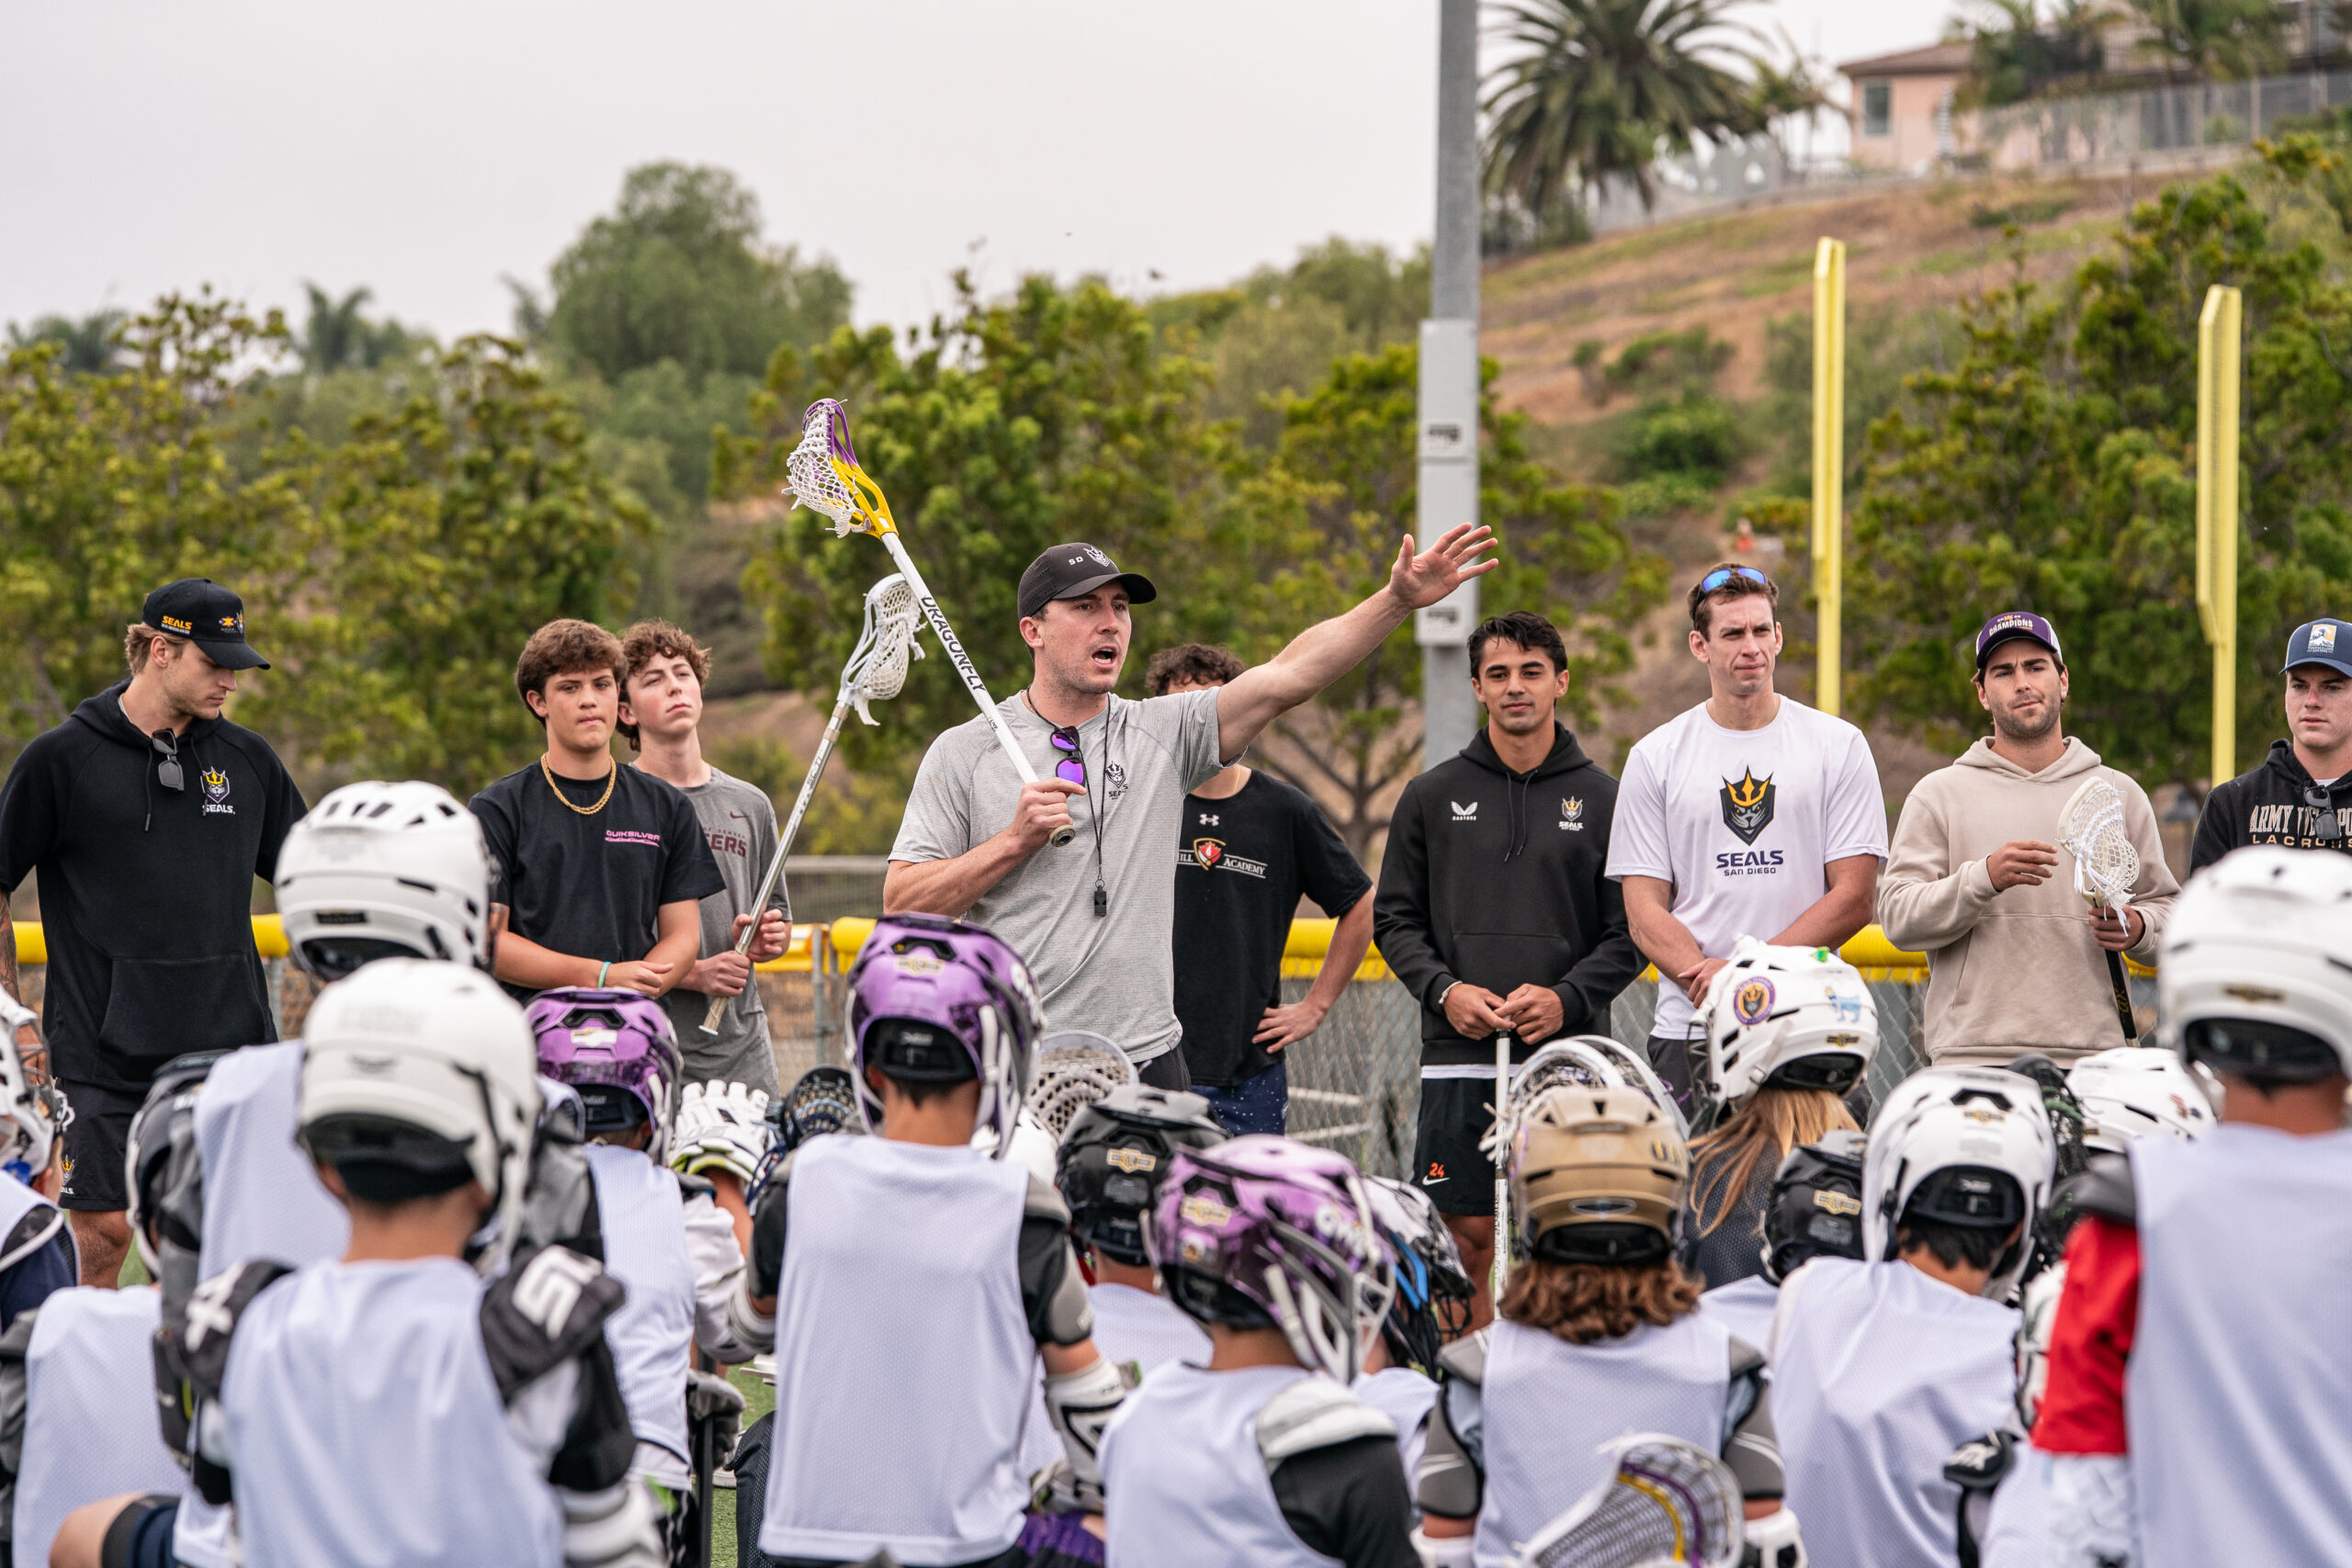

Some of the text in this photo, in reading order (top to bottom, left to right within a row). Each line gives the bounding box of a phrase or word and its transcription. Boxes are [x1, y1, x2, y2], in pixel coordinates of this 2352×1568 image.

[163, 615, 193, 631] SEALS
[2249, 805, 2294, 833] ARMY
[606, 829, 661, 840] QUIKSILVER
[706, 833, 747, 858] ERS
[1180, 853, 1265, 874] ILL ACADEMY
[1716, 850, 1784, 869] SEALS
[1724, 868, 1744, 876] SAN
[1429, 1162, 1445, 1179] 24
